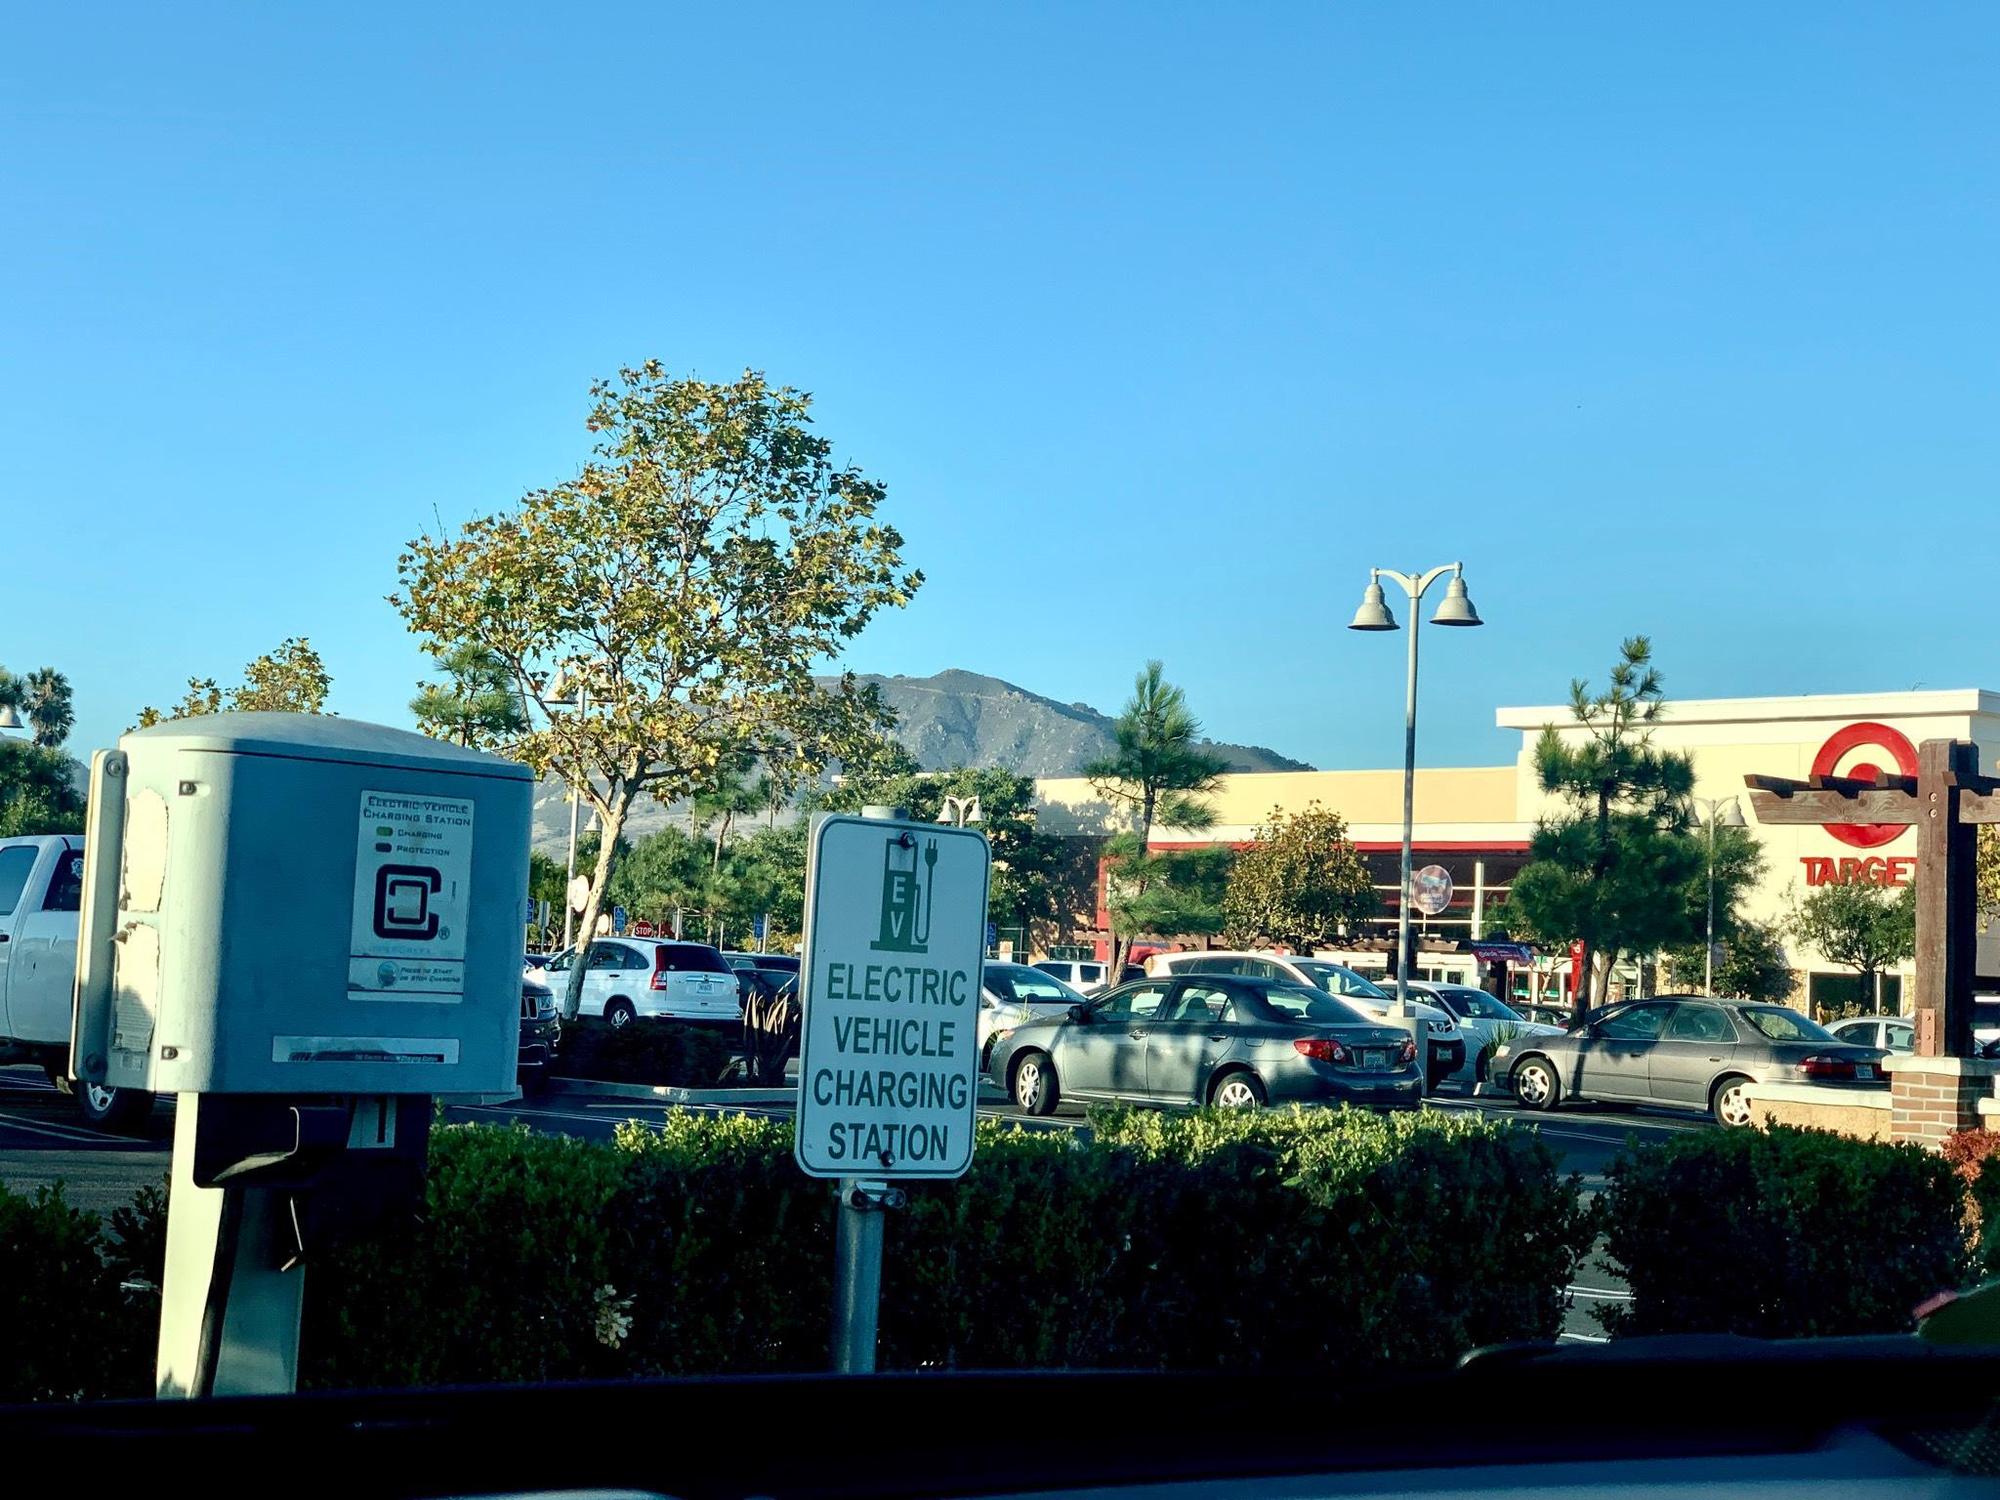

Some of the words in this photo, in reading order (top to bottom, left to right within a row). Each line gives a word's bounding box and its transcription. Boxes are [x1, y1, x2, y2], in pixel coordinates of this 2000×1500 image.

[636, 927, 652, 935] STOP
[827, 963, 967, 1006] ELECTRIC
[834, 1016, 955, 1057] VEHICLE
[814, 1068, 967, 1110] CHARGING
[828, 1122, 948, 1161] STATION
